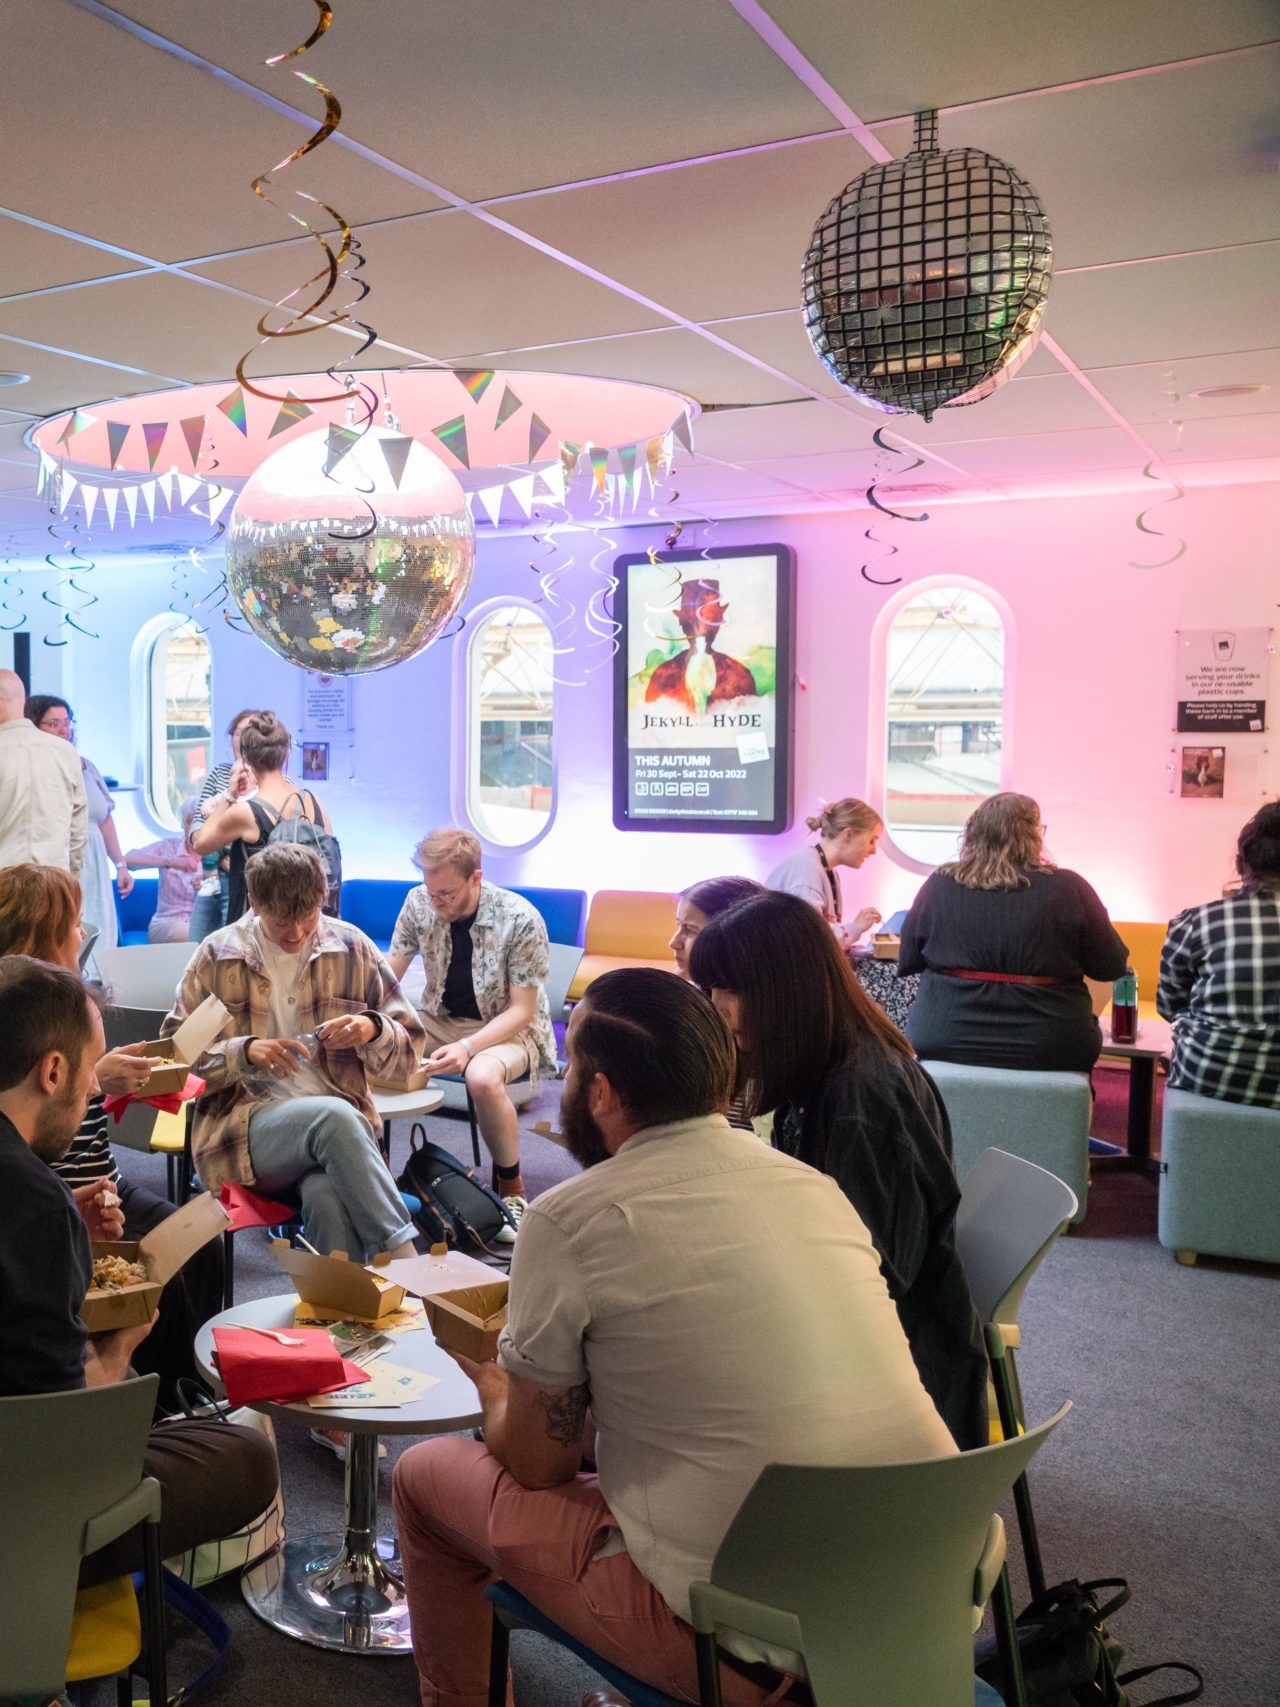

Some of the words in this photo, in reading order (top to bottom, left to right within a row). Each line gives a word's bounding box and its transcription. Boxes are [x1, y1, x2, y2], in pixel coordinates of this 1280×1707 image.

[641, 714, 694, 730] JEKYLL
[713, 714, 761, 728] HYDE
[634, 755, 660, 767] THIS
[661, 755, 711, 767] AUTUMN
[635, 769, 646, 779] Fri
[647, 769, 657, 779] 30
[682, 770, 696, 779] Sat
[697, 770, 708, 779] 22
[709, 770, 724, 779] Oct
[725, 770, 747, 779] 2022
